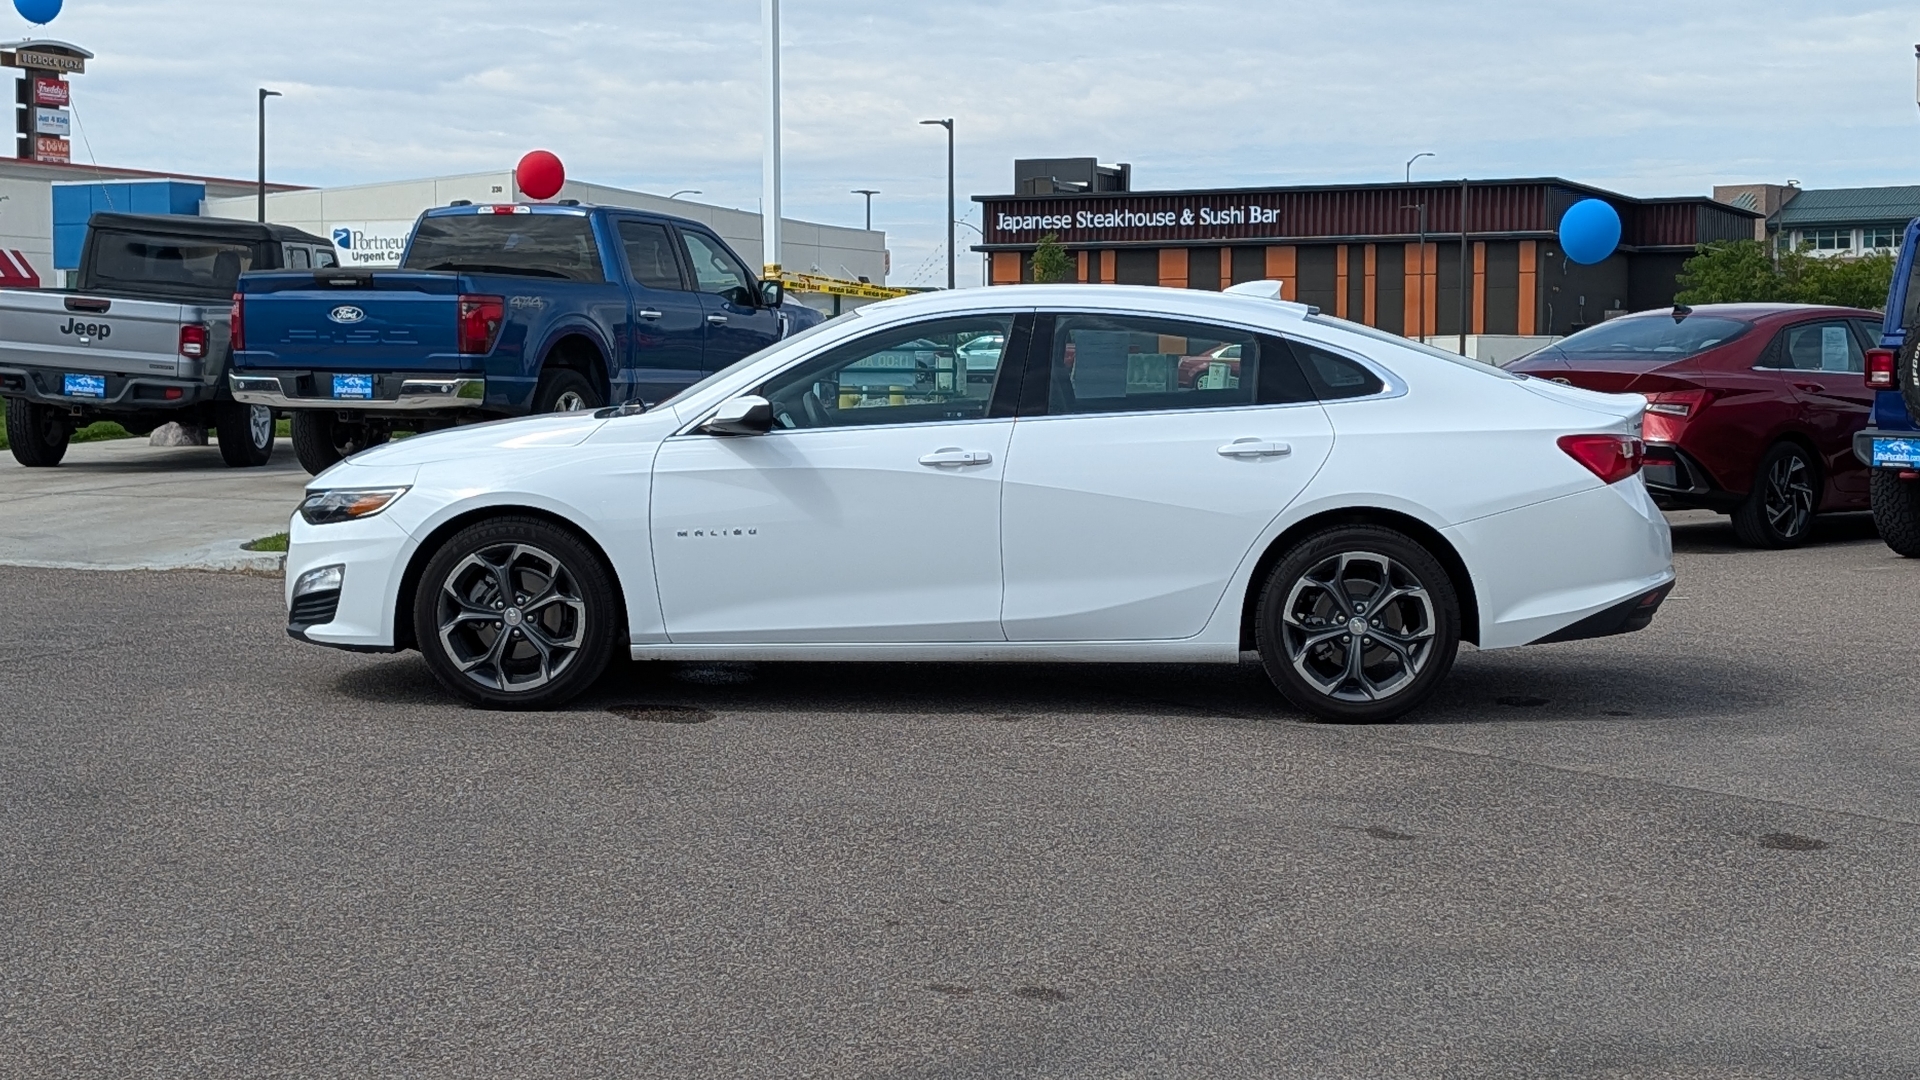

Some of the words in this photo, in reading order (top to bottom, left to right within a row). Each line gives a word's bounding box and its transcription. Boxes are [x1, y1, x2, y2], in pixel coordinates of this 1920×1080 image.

[22, 53, 58, 66] BEDROCK
[60, 58, 83, 69] PLAZA
[996, 212, 1072, 233] Japanese
[1076, 208, 1176, 229] Steakhouse
[1179, 208, 1195, 225] &
[1200, 206, 1245, 225] Sushi
[1249, 205, 1280, 224] Bar
[351, 252, 386, 262] Urgent
[336, 307, 359, 319] Ford
[60, 317, 111, 340] Jeep
[677, 528, 757, 537] MALIBU
